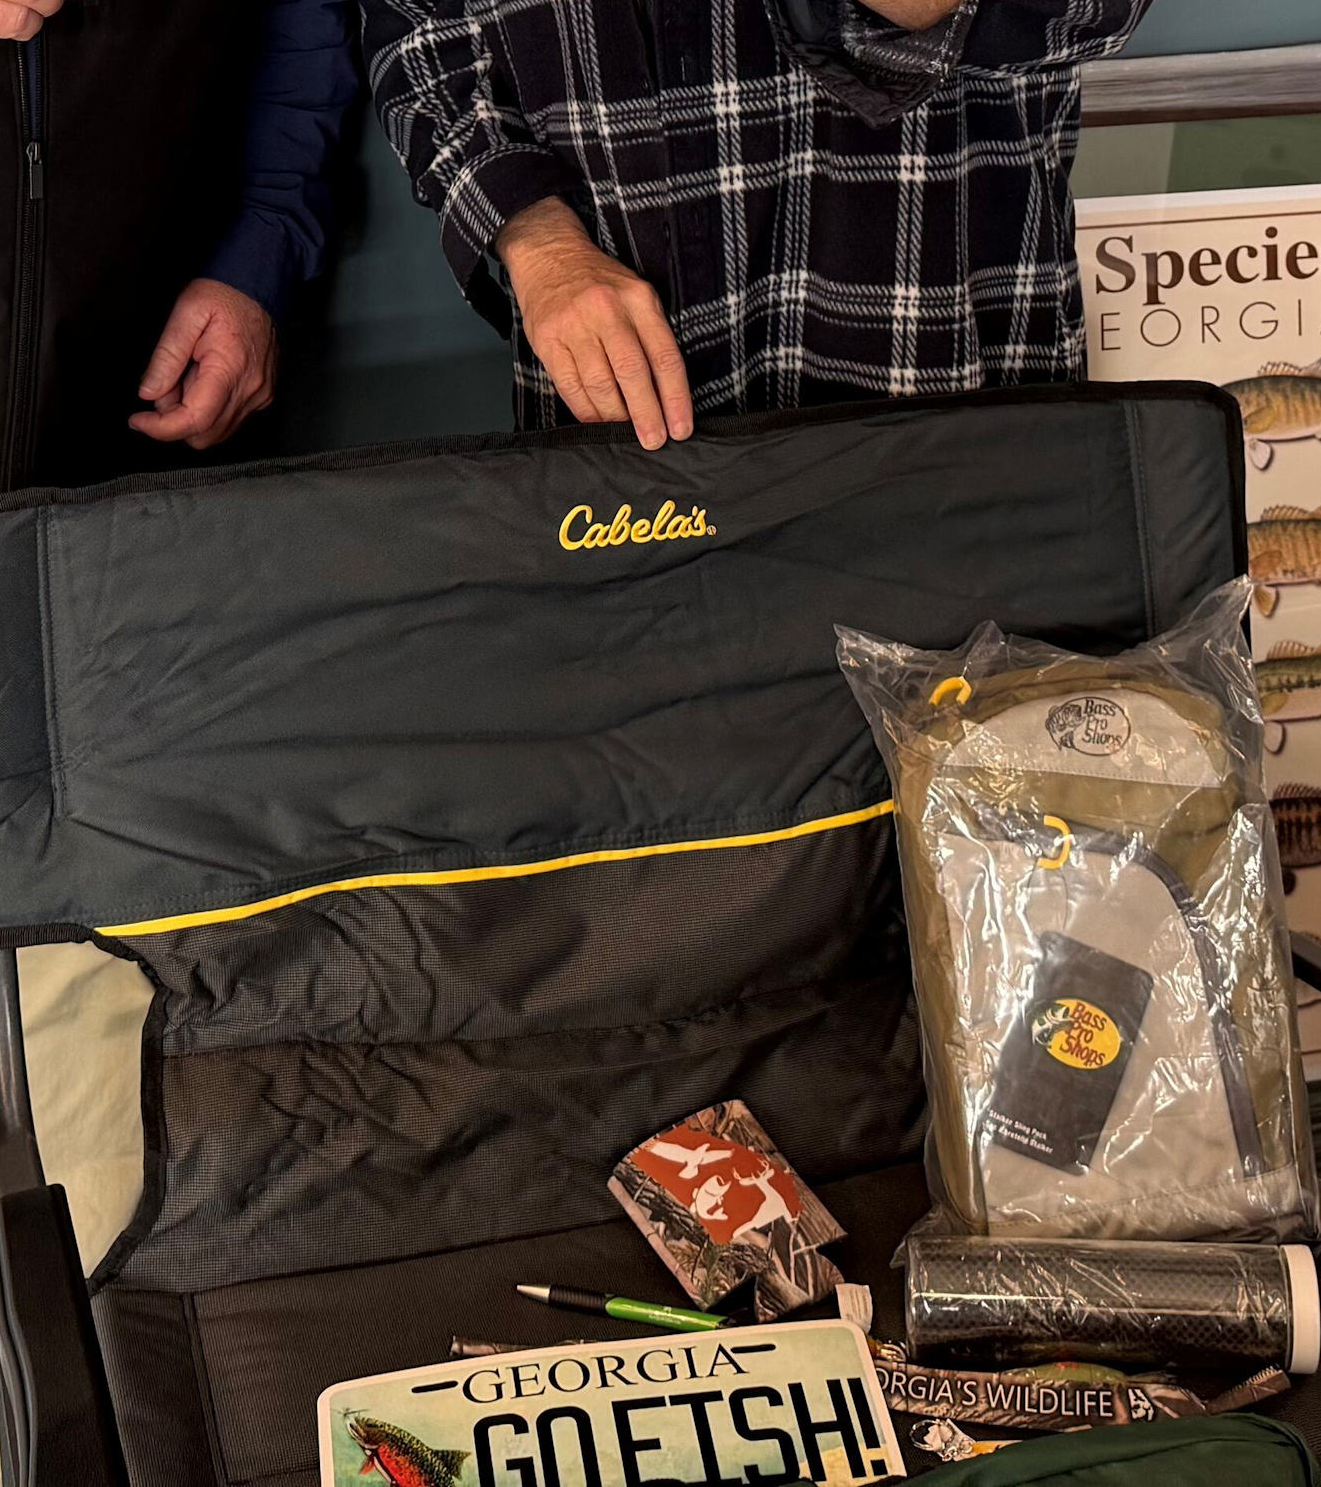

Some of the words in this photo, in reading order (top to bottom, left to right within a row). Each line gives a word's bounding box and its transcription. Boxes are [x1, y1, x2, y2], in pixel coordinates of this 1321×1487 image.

[1083, 698, 1117, 717] Bass
[1085, 714, 1108, 732] Pro
[1081, 730, 1123, 749] Shops
[1069, 1001, 1108, 1031] Bass
[1065, 1020, 1094, 1044] Pro
[1059, 1035, 1106, 1067] Shops
[462, 1343, 750, 1404] GEORGIA
[986, 1381, 1113, 1417] WILDLIFE
